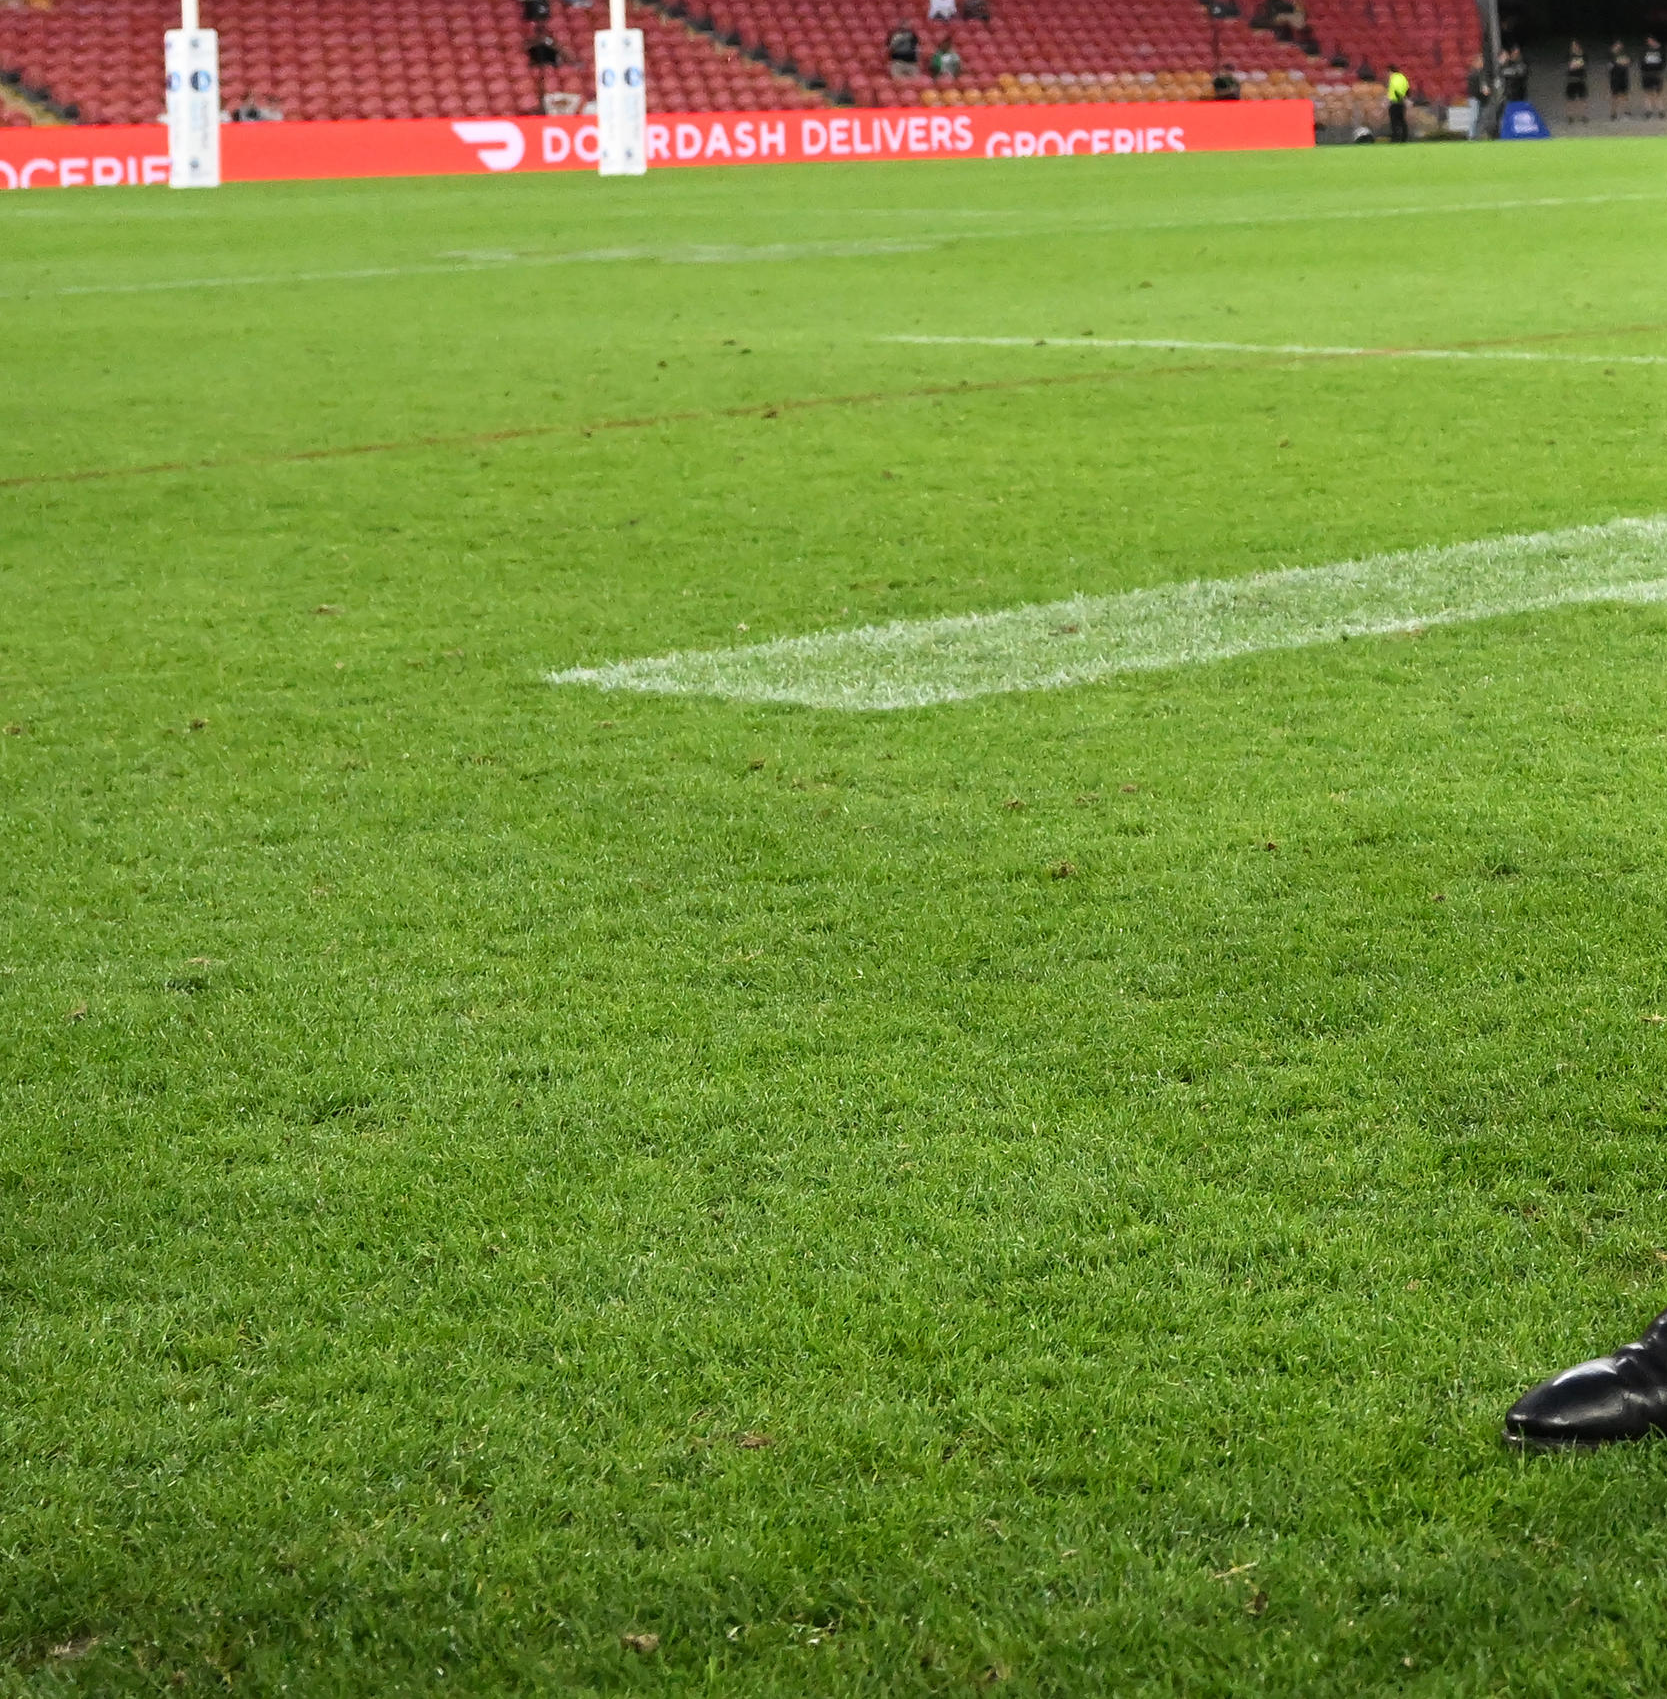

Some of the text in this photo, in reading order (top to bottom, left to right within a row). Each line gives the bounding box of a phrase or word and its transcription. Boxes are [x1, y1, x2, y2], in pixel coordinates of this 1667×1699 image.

[543, 115, 974, 163] DORDASH DELIVERS
[985, 127, 1185, 158] GROCERIES
